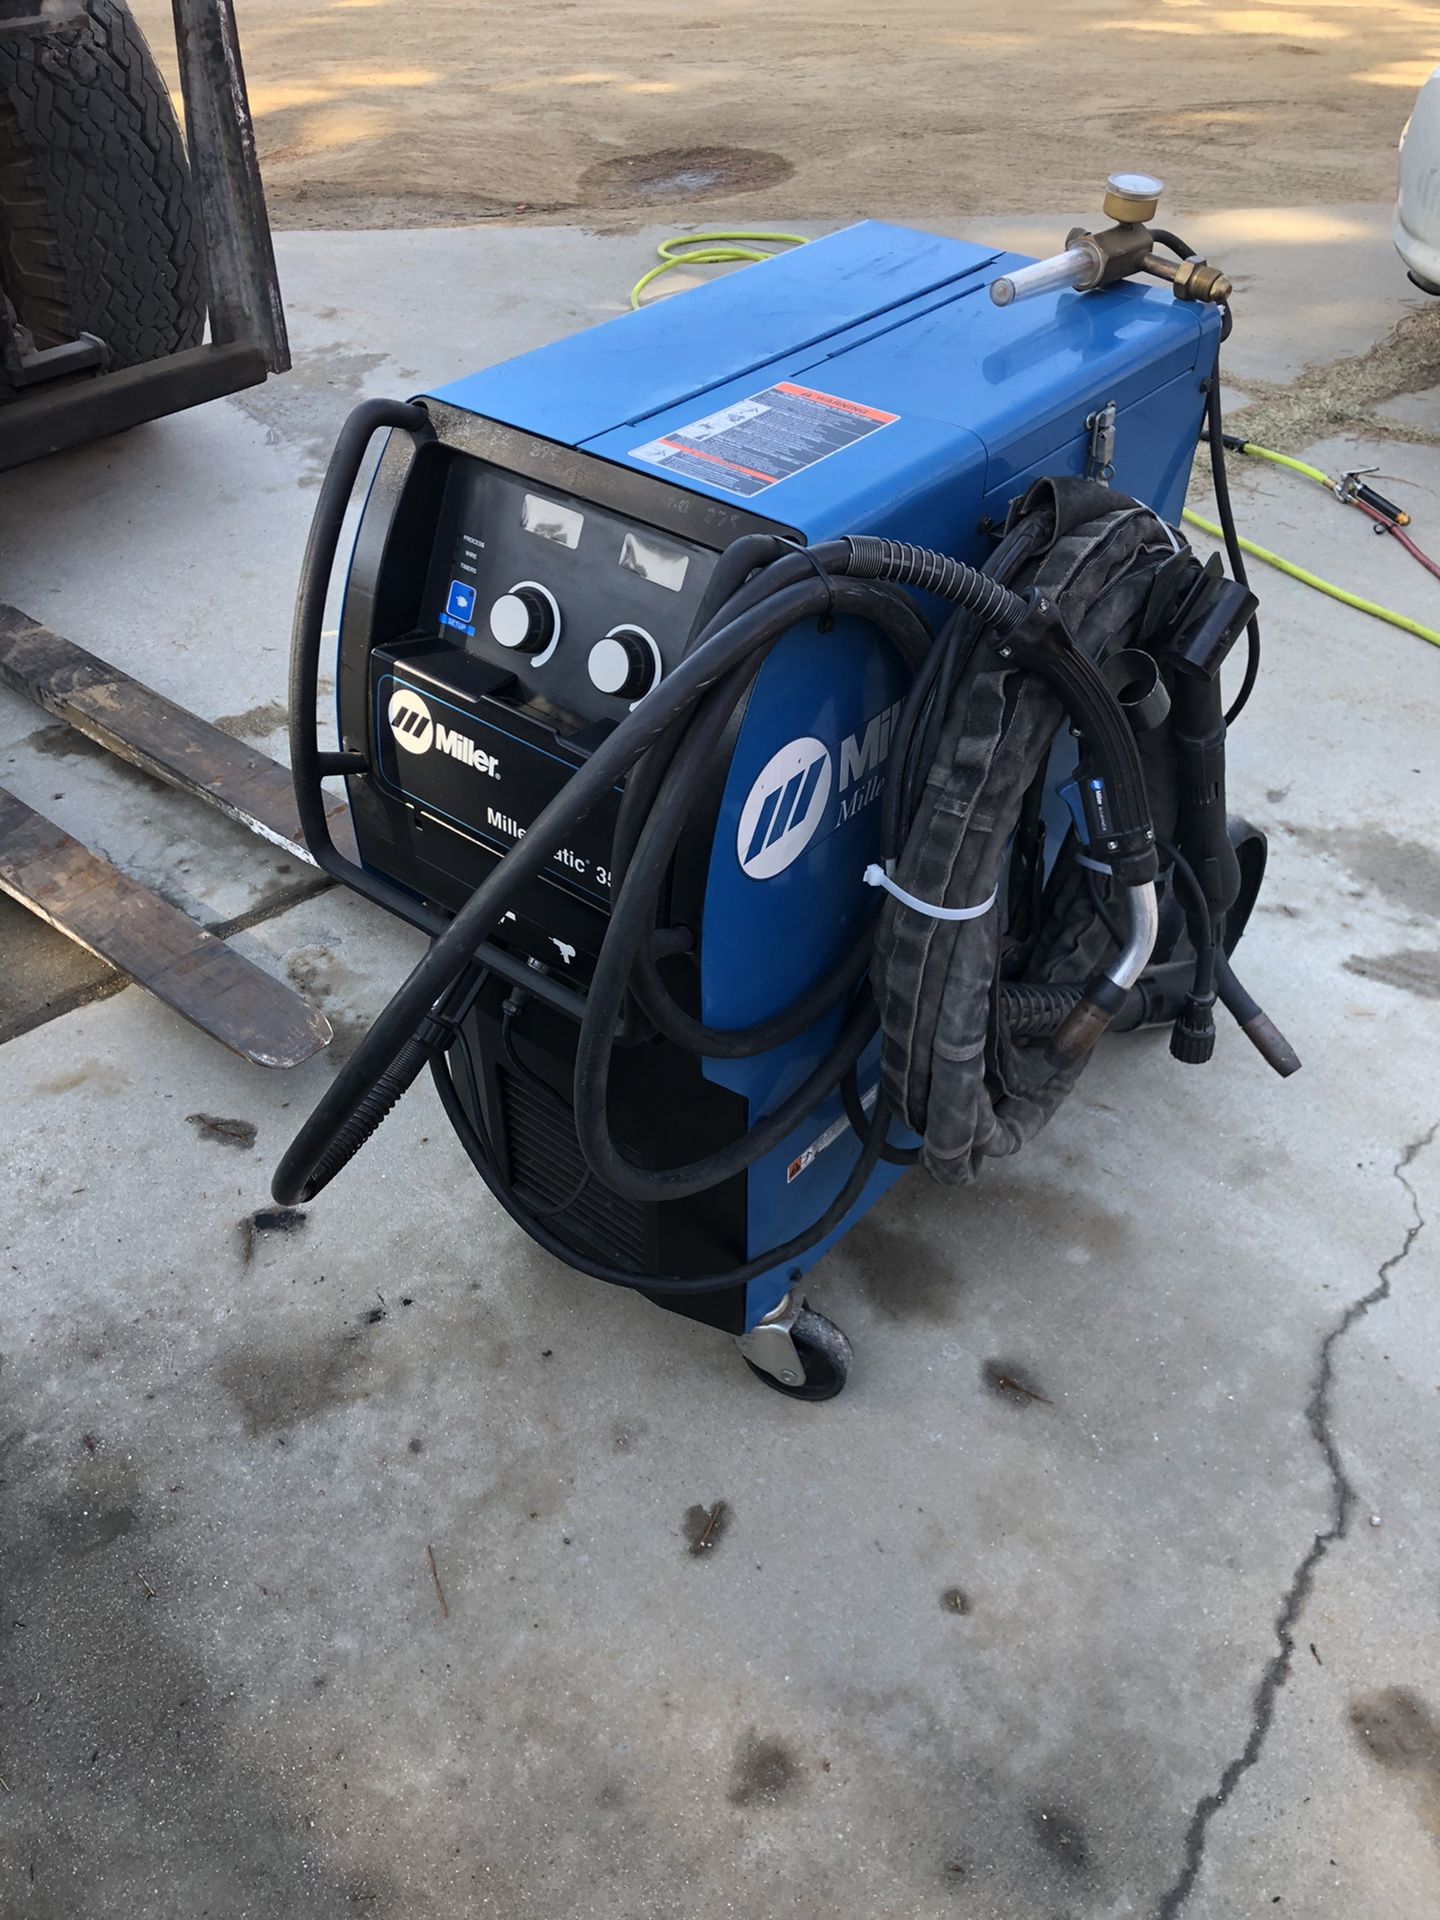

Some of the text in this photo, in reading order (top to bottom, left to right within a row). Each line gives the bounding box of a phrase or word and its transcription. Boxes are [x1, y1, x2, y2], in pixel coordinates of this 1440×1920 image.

[816, 395, 870, 414] WARNING
[463, 534, 486, 548] PROCESS
[448, 617, 467, 631] SETUP
[833, 775, 886, 831] Mille
